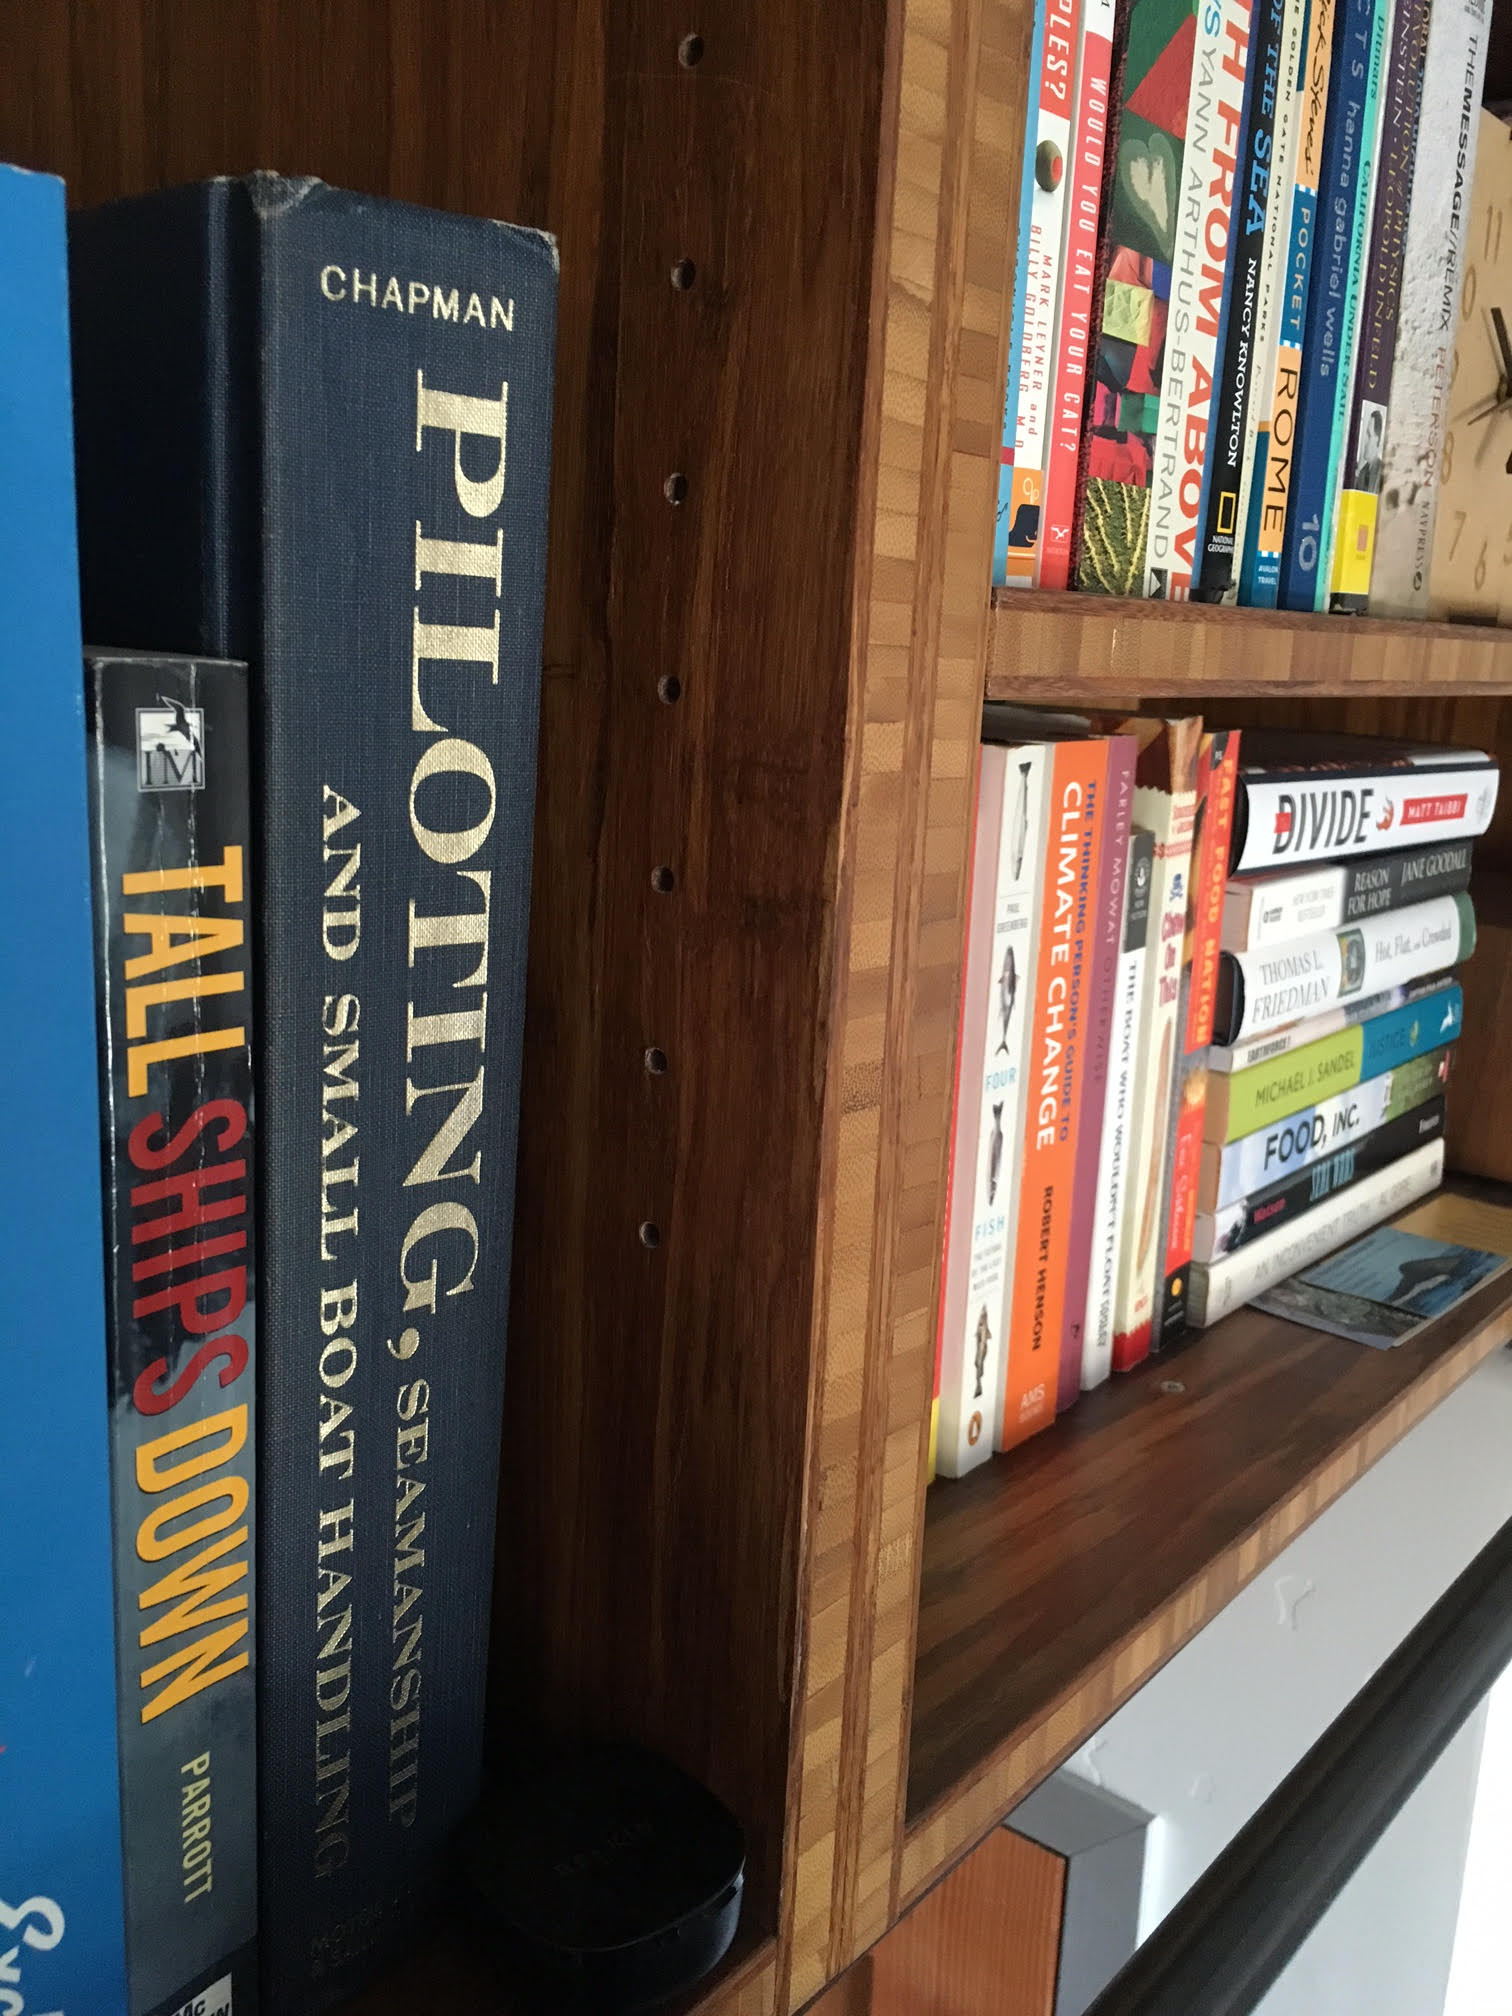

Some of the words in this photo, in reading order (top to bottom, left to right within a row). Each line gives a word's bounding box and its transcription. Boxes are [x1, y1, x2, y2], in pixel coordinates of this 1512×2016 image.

[1260, 43, 1280, 119] THE
[1285, 27, 1298, 102] GOLDEN
[1370, 15, 1385, 100] Ditmars
[1084, 76, 1107, 168] WOULD
[1192, 47, 1217, 153] YANN
[1278, 113, 1289, 163] GATE
[1245, 128, 1272, 236] SEA
[1340, 100, 1361, 188] hanna
[1078, 184, 1098, 233] YOU
[1195, 100, 1241, 338] FROM
[1266, 175, 1282, 272] NATIONAL
[1350, 160, 1372, 287] CALIFORNIA
[1378, 152, 1398, 284] LEOPOLD
[1038, 255, 1053, 307] MARK
[1072, 247, 1093, 296] EAT
[1289, 207, 1312, 331] POCKET
[1328, 196, 1348, 299] gabriel
[1385, 208, 1404, 321] PHYSICS
[319, 265, 514, 331] CHAPMAN
[1239, 257, 1257, 339] NANCY
[1260, 284, 1271, 342] PARKS
[1342, 293, 1358, 368] UNDER
[1031, 321, 1047, 390] LEYNER
[1065, 311, 1088, 375] YOUR
[1154, 166, 1203, 559] ARTHUS-BERTRAND
[1320, 306, 1337, 377] wells
[1028, 404, 1038, 436] and
[1059, 392, 1081, 453] CAT?
[1227, 340, 1249, 467] KNOWLTON
[1337, 373, 1350, 423] SAIL
[1423, 346, 1447, 488] PETERSON
[1168, 355, 1213, 600] ABOVE
[1263, 366, 1298, 533] ROME
[1298, 513, 1320, 571] 10
[1085, 780, 1097, 821] THE
[1115, 770, 1130, 846] FARLEY
[1218, 759, 1233, 829] FAST
[1272, 788, 1374, 854] DIVIDE
[1408, 803, 1432, 819] MATT
[1433, 800, 1462, 816] TAIBBI
[322, 784, 362, 961] AND
[387, 368, 508, 1360] PILOTING,
[1050, 781, 1083, 966] CLIMATE
[1075, 828, 1093, 934] THINKING
[1106, 857, 1122, 944] MOWAT
[1208, 846, 1225, 923] FOOD
[1347, 894, 1368, 916] FOR
[1367, 887, 1392, 911] HOPE
[1354, 867, 1390, 892] REASON
[1400, 857, 1426, 886] JANE
[1425, 849, 1467, 877] GOODALL
[122, 845, 246, 1098] TALL
[1067, 939, 1083, 1041] PERSON'S
[1126, 960, 1137, 1004] THE
[1196, 938, 1216, 1043] NATION
[1251, 975, 1330, 1024] FRIEDMAN
[1259, 956, 1312, 986] THOMAS
[1036, 976, 1067, 1151] CHANGE
[1121, 1008, 1133, 1063] BOAT
[1061, 1044, 1075, 1108] GUIDE
[1117, 1070, 1128, 1120] WHO
[1255, 1066, 1305, 1107] MICHAEL
[1317, 1051, 1355, 1080] SANDEL
[319, 993, 361, 1261] SMALL
[1059, 1112, 1070, 1142] TO
[1264, 1114, 1327, 1171] FOOD,
[1332, 1104, 1360, 1137] INC.
[127, 1098, 249, 1417] SHIPS
[974, 1215, 1005, 1241] FISH
[1038, 1185, 1054, 1261] ROBERT
[1102, 1233, 1115, 1297] FLOAT
[1032, 1268, 1047, 1351] HENSON
[318, 1279, 359, 1480] BOAT
[135, 1403, 250, 1725] DOWN
[388, 1378, 430, 1828] SEAMANSHIP
[314, 1498, 355, 1879] HANDLING
[180, 1750, 213, 1905] PARROTT
